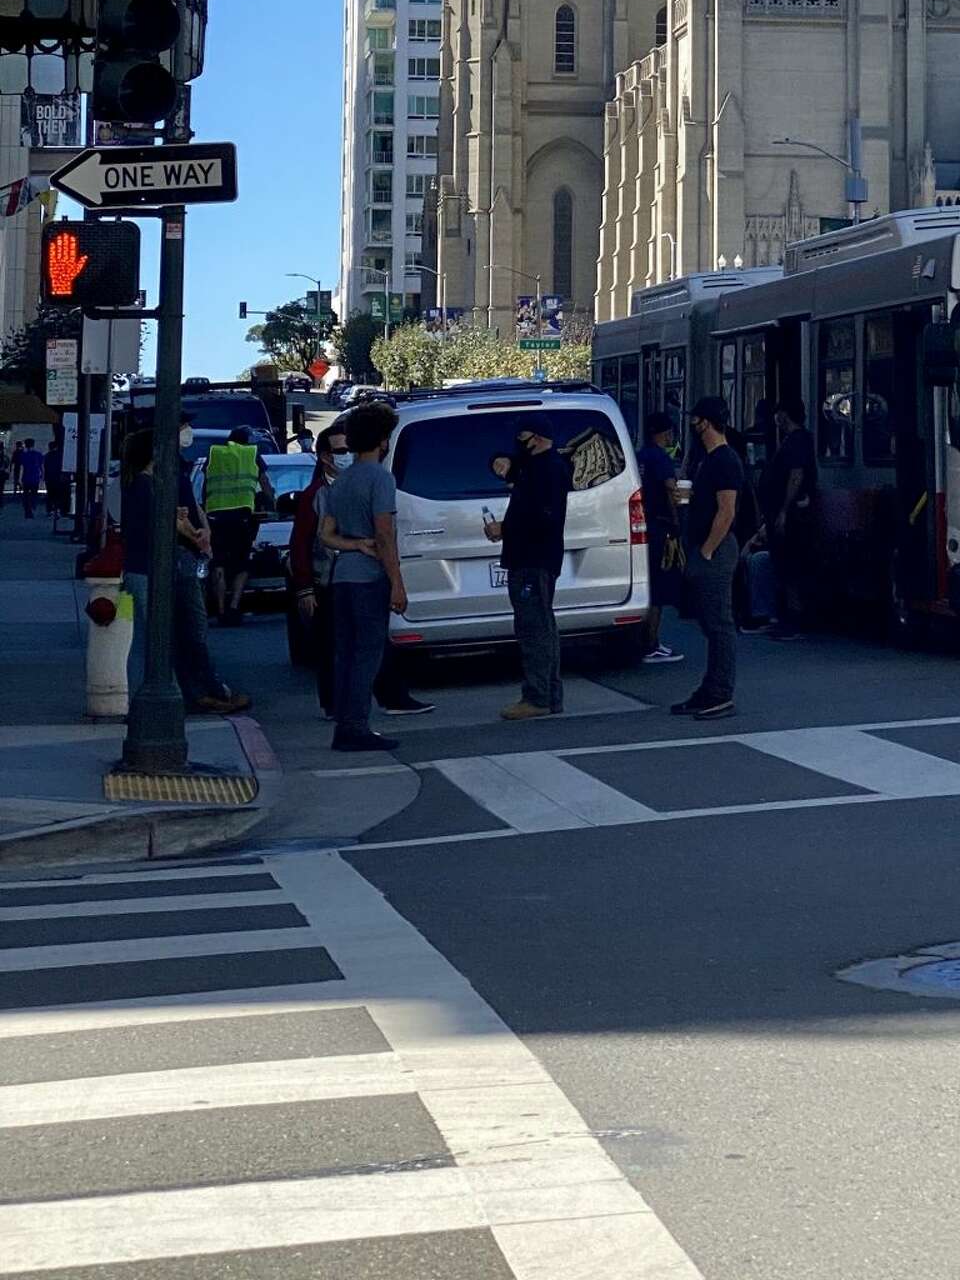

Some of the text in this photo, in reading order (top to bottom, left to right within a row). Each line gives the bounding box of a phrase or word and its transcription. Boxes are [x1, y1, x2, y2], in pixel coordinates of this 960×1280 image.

[36, 105, 66, 120] BOLD
[36, 120, 67, 134] THEN
[104, 162, 216, 189] ONE WAY
